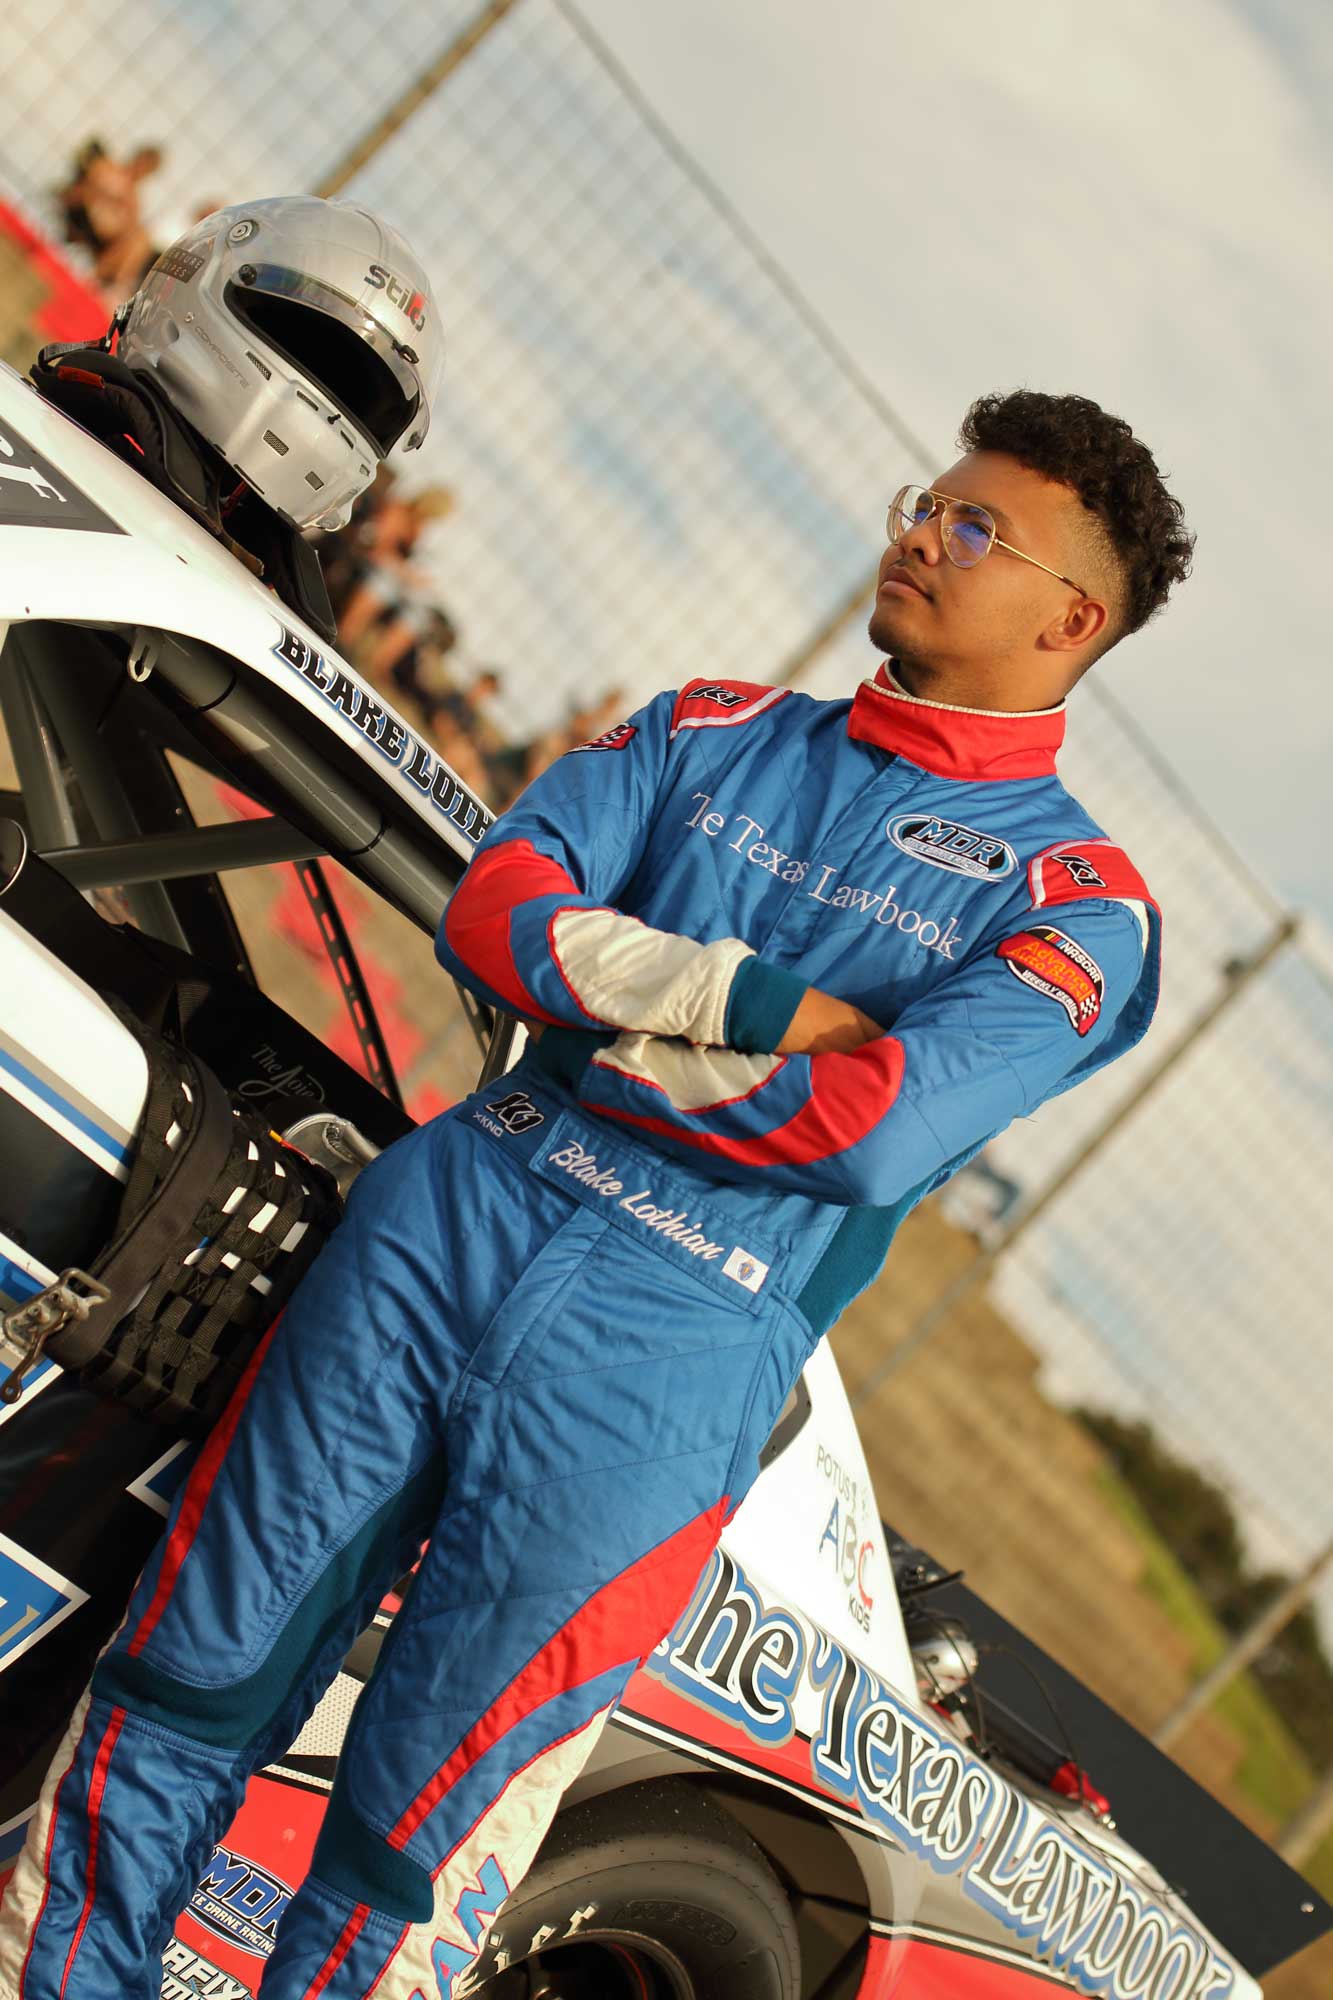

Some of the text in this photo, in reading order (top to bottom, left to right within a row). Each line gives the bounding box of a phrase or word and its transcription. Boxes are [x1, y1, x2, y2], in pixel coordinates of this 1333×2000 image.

[363, 264, 426, 332] Stilo
[278, 627, 405, 762] BLAKE
[912, 818, 1004, 865] MDR
[684, 792, 962, 961] Te Texas Lawbook
[1007, 948, 1046, 971] Auto
[1021, 969, 1058, 994] WEEKLY
[1058, 942, 1101, 984] NASCAR
[250, 1043, 282, 1073] The
[485, 1091, 545, 1135] K1
[549, 1139, 725, 1260] Blake Lothian
[818, 1496, 875, 1611] ABC
[848, 1594, 872, 1635] KIDS
[657, 1545, 1233, 2000] he Texas Lawbook
[204, 1902, 239, 1931] DARNE
[161, 1937, 254, 2000] AFIX
